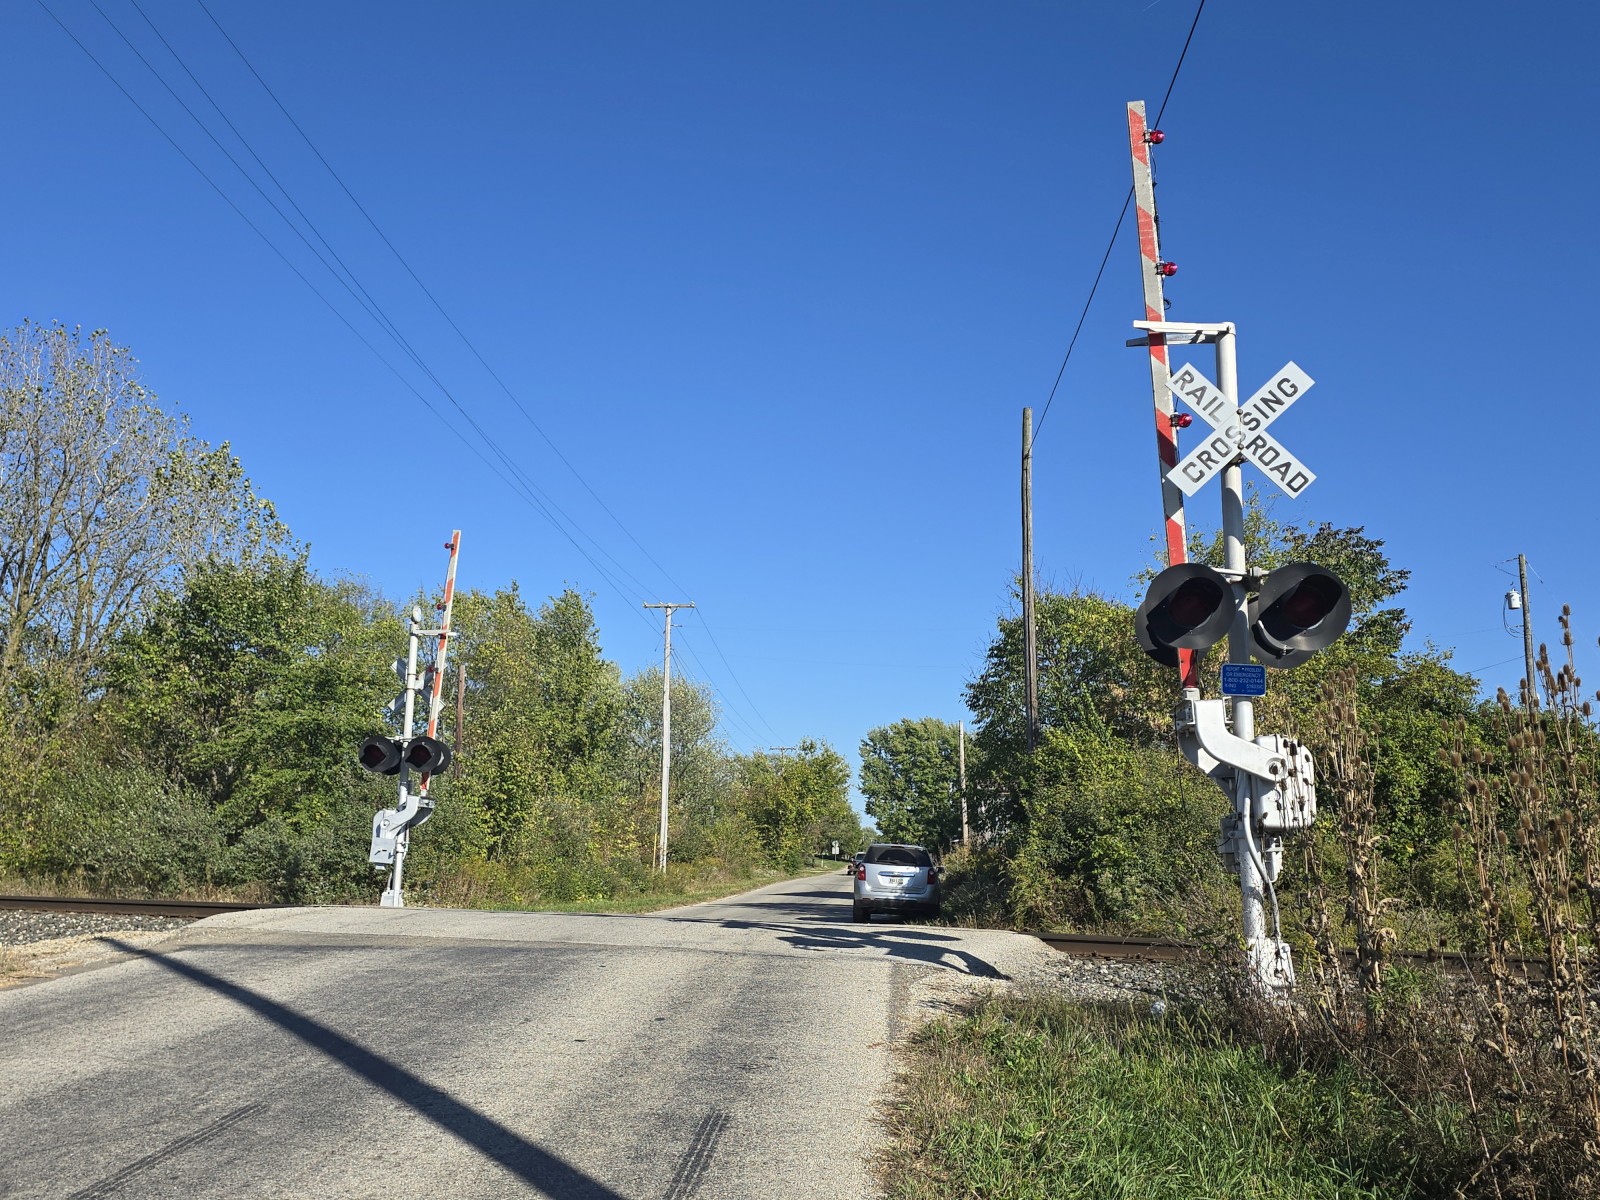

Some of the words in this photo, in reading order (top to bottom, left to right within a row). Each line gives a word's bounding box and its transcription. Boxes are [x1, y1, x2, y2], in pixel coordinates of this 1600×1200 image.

[1173, 370, 1226, 424] RAIL
[1245, 434, 1309, 493] ROAD
[1182, 377, 1299, 483] CROSSING
